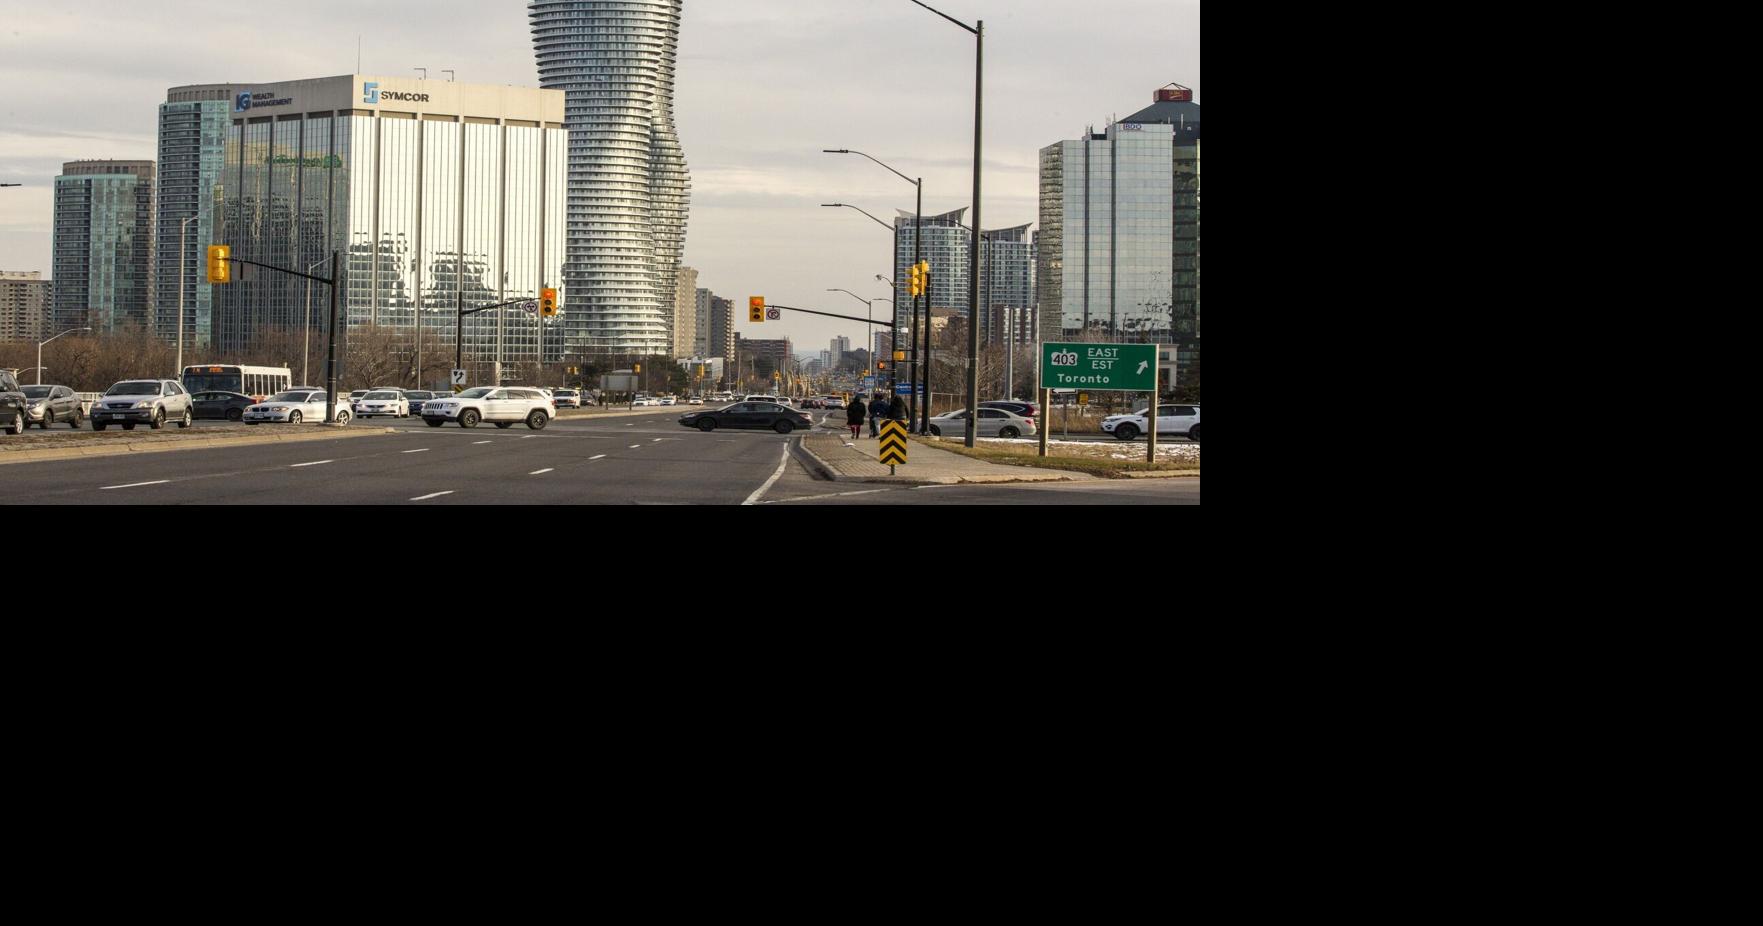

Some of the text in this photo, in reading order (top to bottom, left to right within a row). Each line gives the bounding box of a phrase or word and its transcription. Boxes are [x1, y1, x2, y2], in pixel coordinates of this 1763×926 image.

[252, 92, 275, 100] WEALTH
[381, 91, 430, 102] SYMCOR
[235, 92, 251, 111] IG
[252, 98, 292, 108] MANAGEMENT
[1087, 347, 1119, 357] EAST
[1053, 354, 1076, 365] 403
[1091, 360, 1114, 370] EST
[1057, 373, 1110, 384] Toronto
